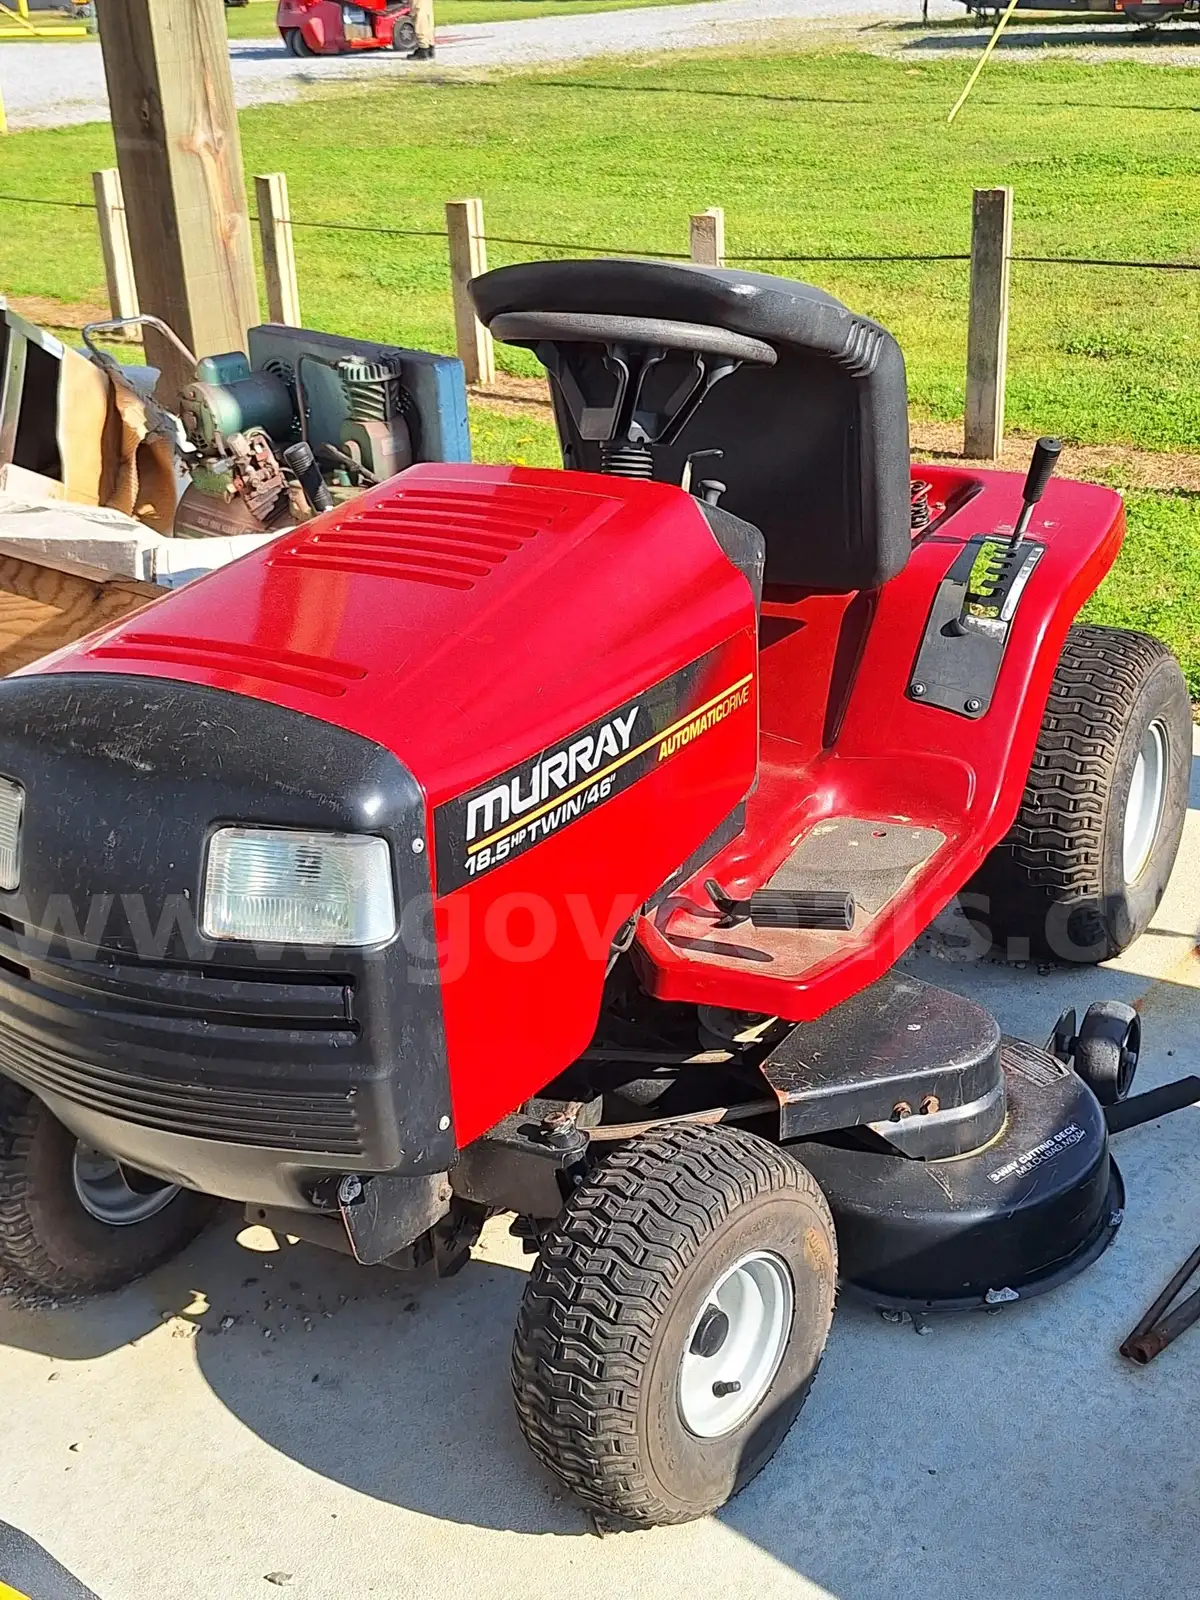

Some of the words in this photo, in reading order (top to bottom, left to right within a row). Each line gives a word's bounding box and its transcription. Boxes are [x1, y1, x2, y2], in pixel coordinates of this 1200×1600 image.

[466, 706, 639, 841] MURRAY
[990, 1160, 1019, 1181] 3-WAY
[1019, 1139, 1055, 1164] CUTTING
[1053, 1124, 1078, 1142] DECK
